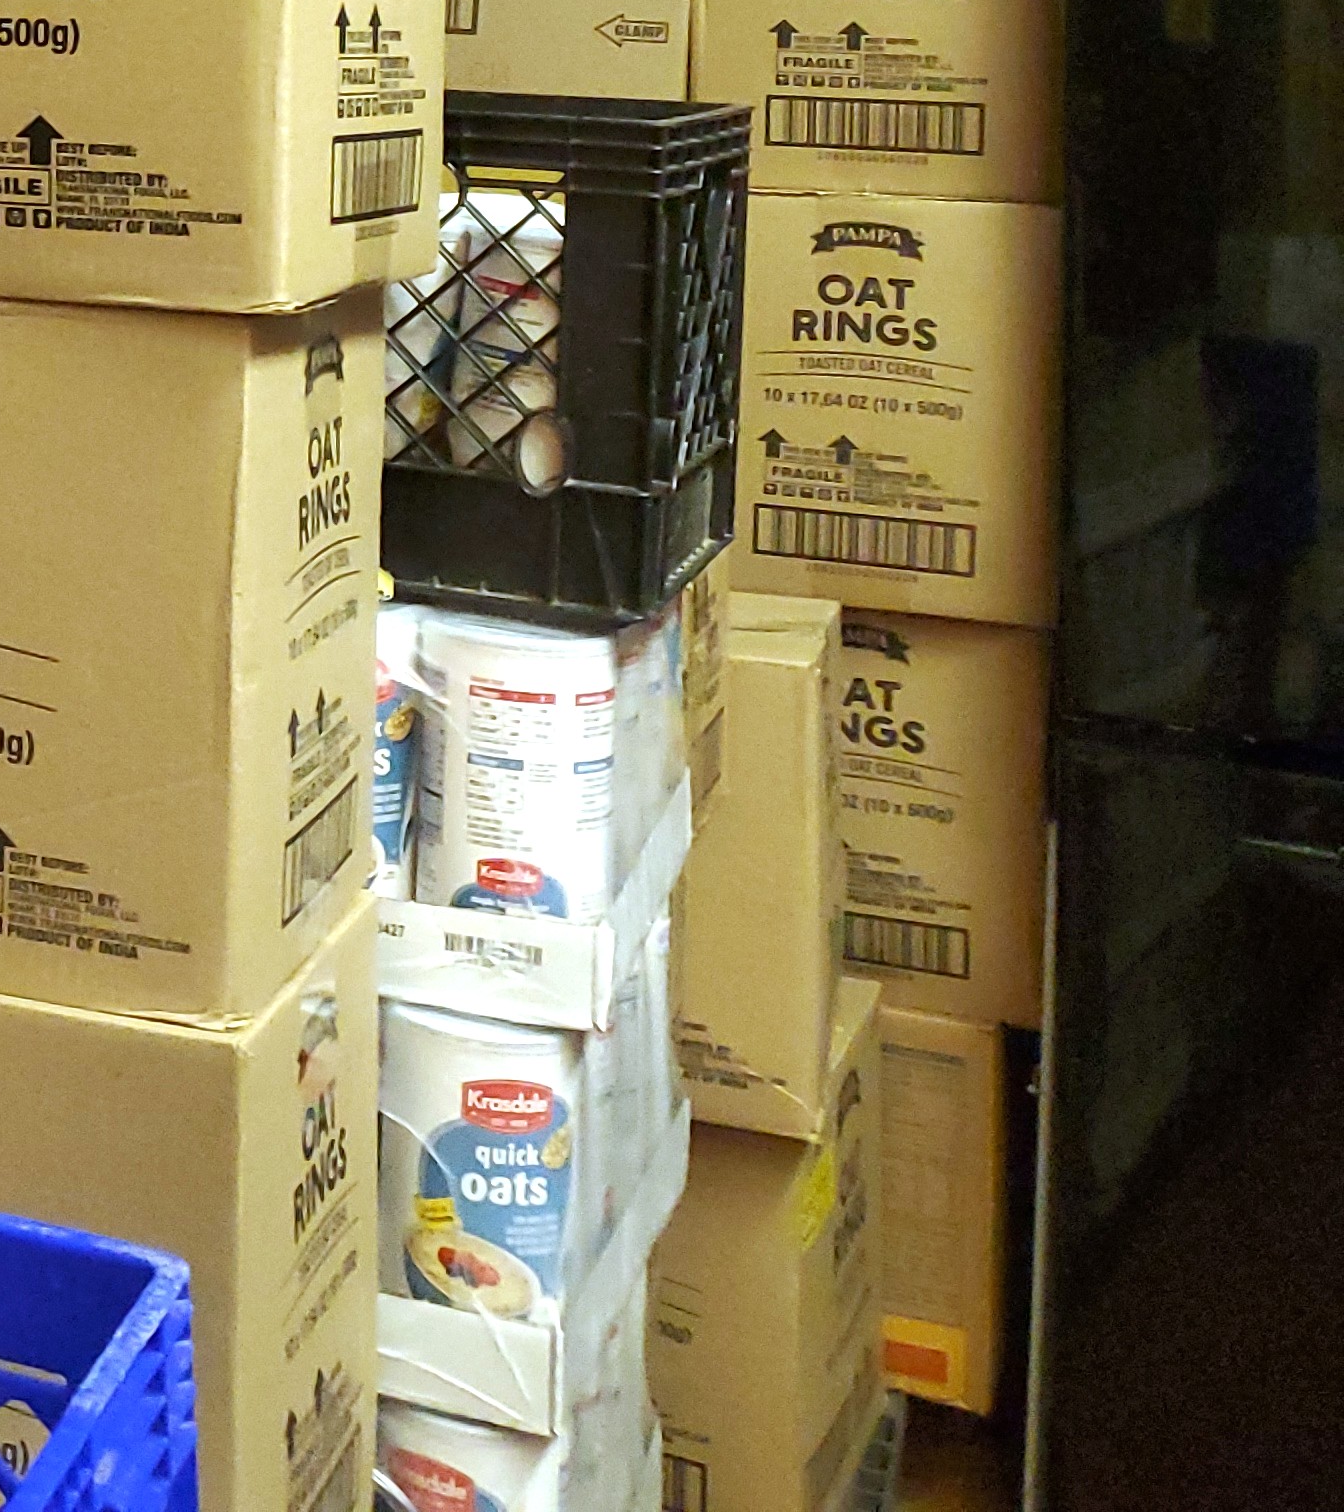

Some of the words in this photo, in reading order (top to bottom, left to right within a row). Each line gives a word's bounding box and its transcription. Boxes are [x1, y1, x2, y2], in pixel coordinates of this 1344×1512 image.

[615, 24, 663, 37] CLAMP
[783, 57, 854, 69] FRAGILE
[833, 227, 901, 245] PAMPA
[818, 274, 914, 310] OAT
[792, 309, 938, 351] RINGS
[308, 416, 342, 479] OAT
[299, 471, 350, 551] RINGS
[467, 1090, 548, 1114] Krasdale
[301, 1085, 337, 1162] OAT
[475, 1143, 540, 1168] quick
[293, 1127, 349, 1245] RINGS
[461, 1171, 548, 1206] oats
